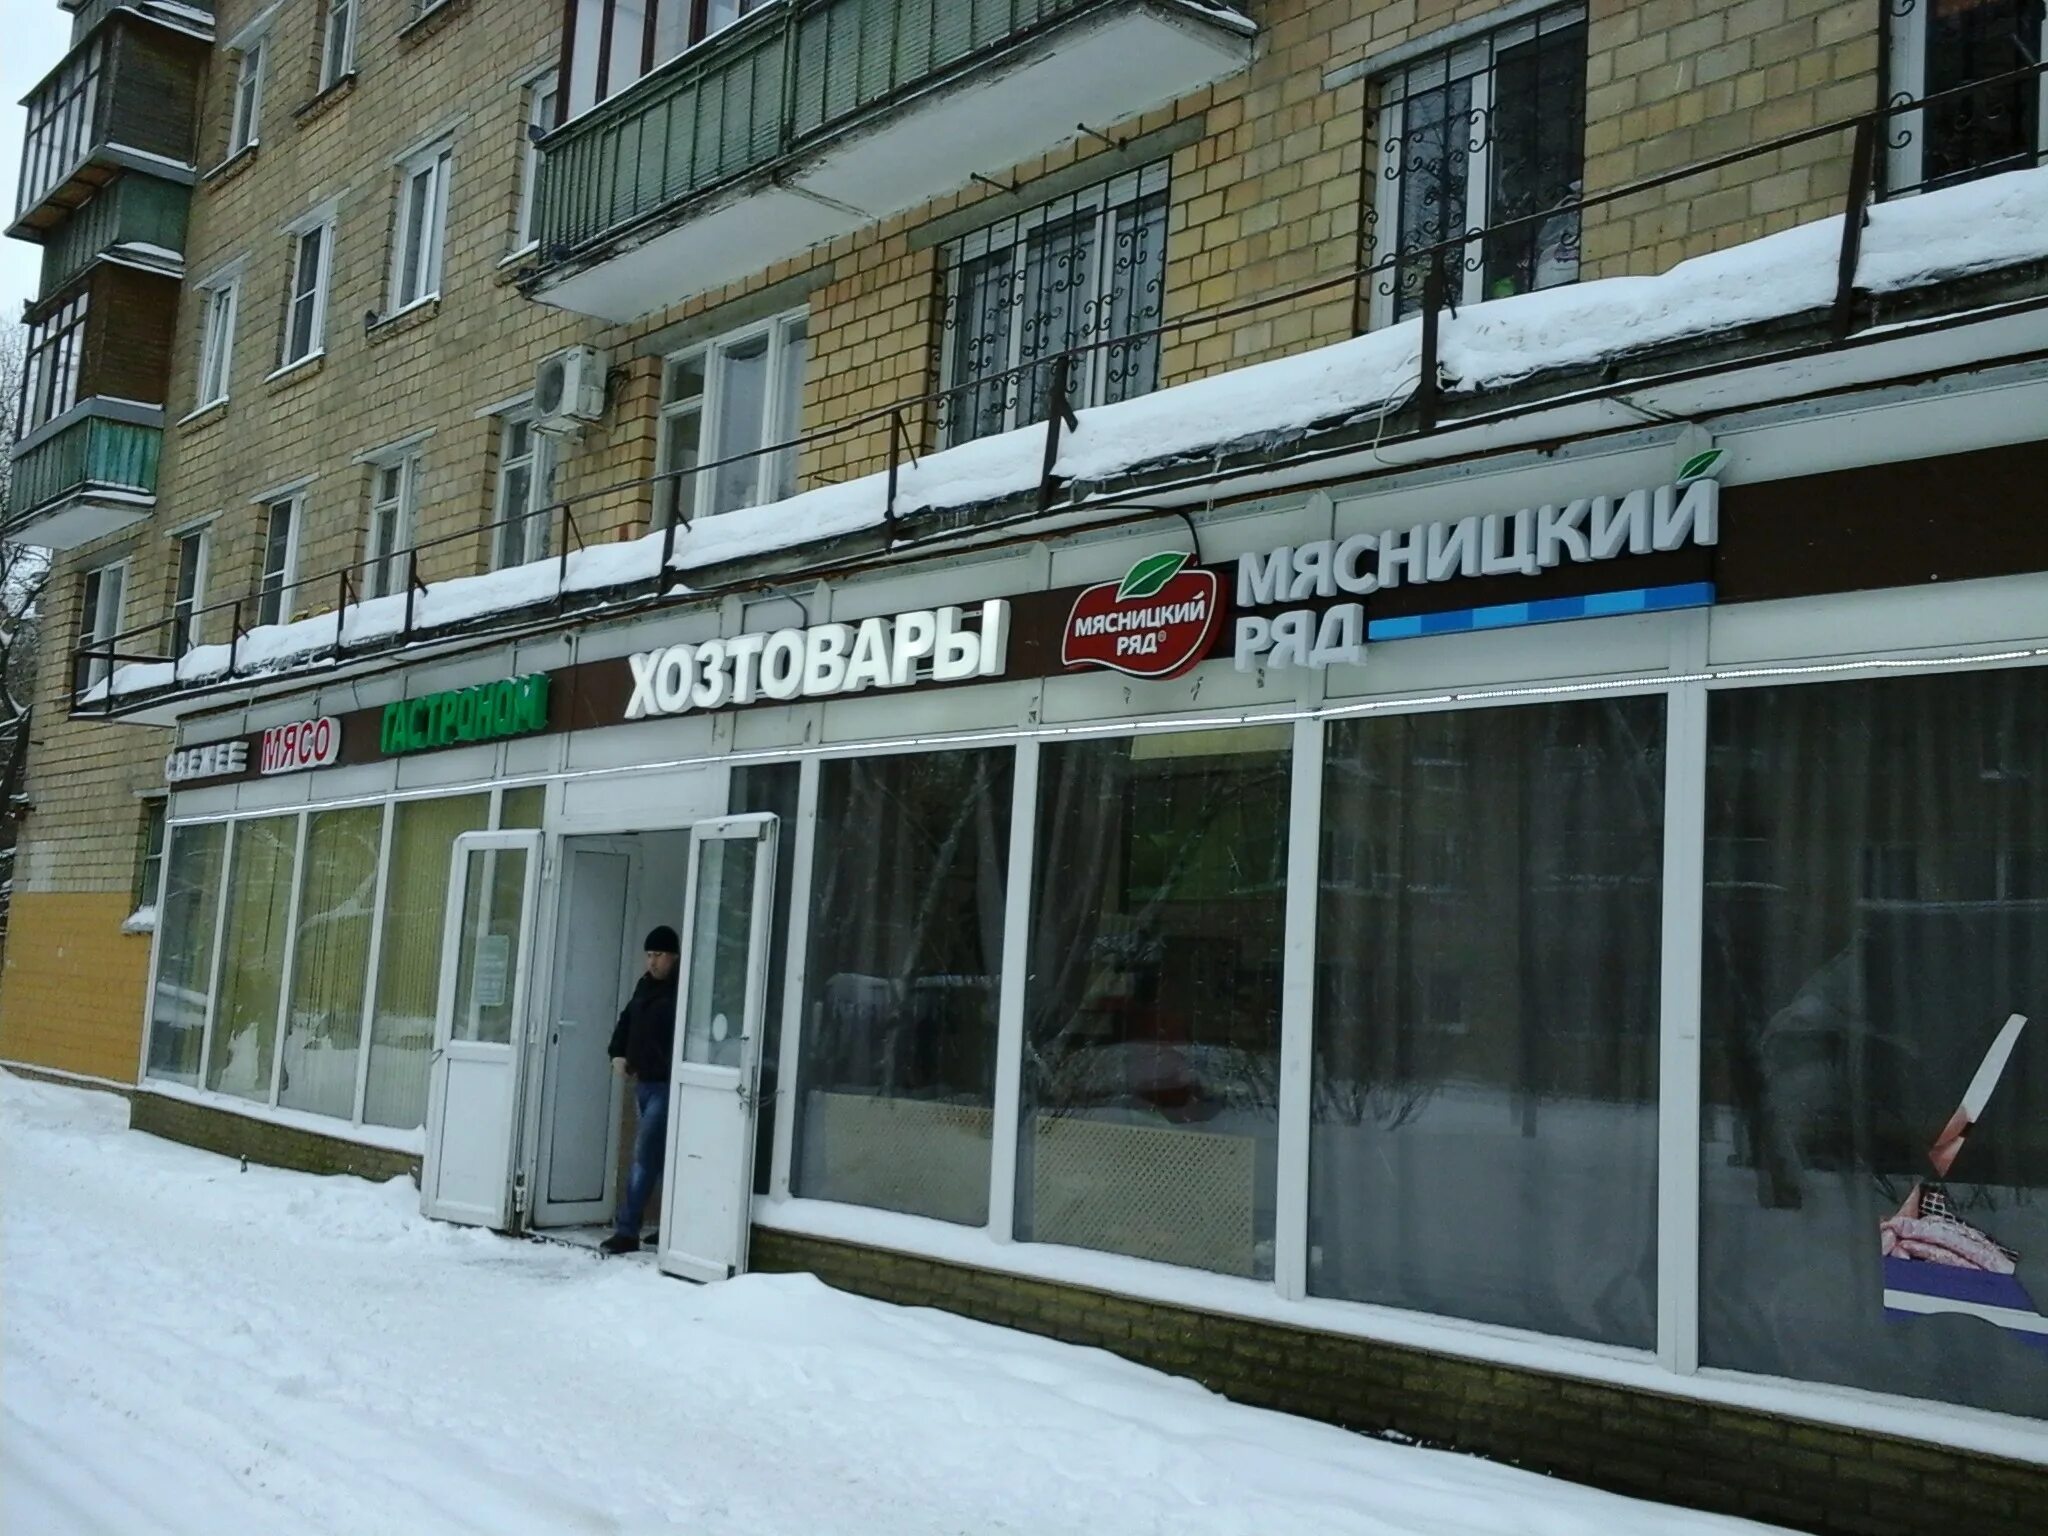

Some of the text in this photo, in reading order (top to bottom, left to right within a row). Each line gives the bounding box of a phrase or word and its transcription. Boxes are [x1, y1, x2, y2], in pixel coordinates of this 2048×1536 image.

[1235, 478, 1719, 608] МЯСНИЦКИЙ
[1075, 590, 1206, 637] МЯСНИЦКИЙ
[1235, 603, 1366, 672] РЯД
[624, 599, 1011, 719] ХОЗТОВАРЫ
[261, 717, 340, 774] МЯСО
[380, 671, 549, 754] ГАСТРОНОМ
